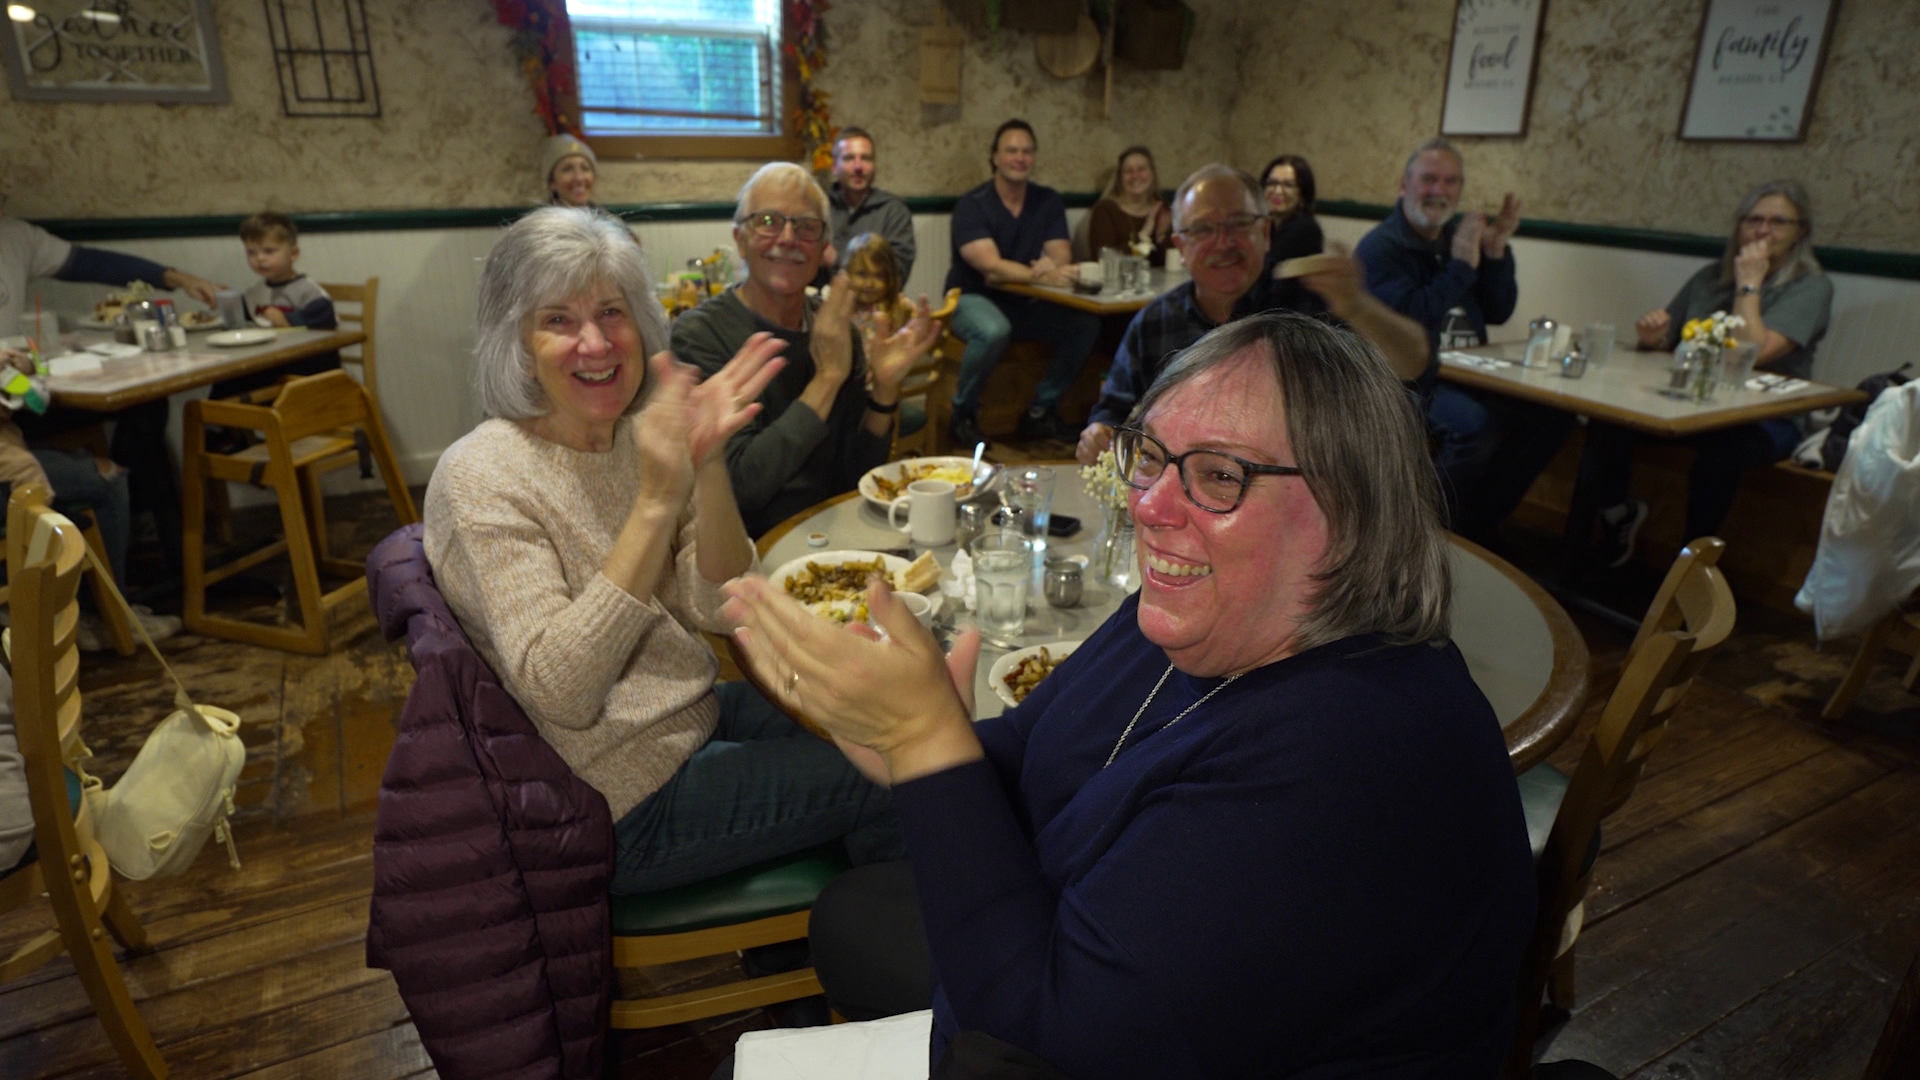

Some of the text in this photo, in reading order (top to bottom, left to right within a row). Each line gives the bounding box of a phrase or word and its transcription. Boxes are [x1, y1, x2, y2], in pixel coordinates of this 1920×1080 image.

[29, 0, 188, 72] gather
[74, 43, 194, 63] TOGETHER
[1469, 34, 1520, 80] food
[1712, 15, 1809, 73] family
